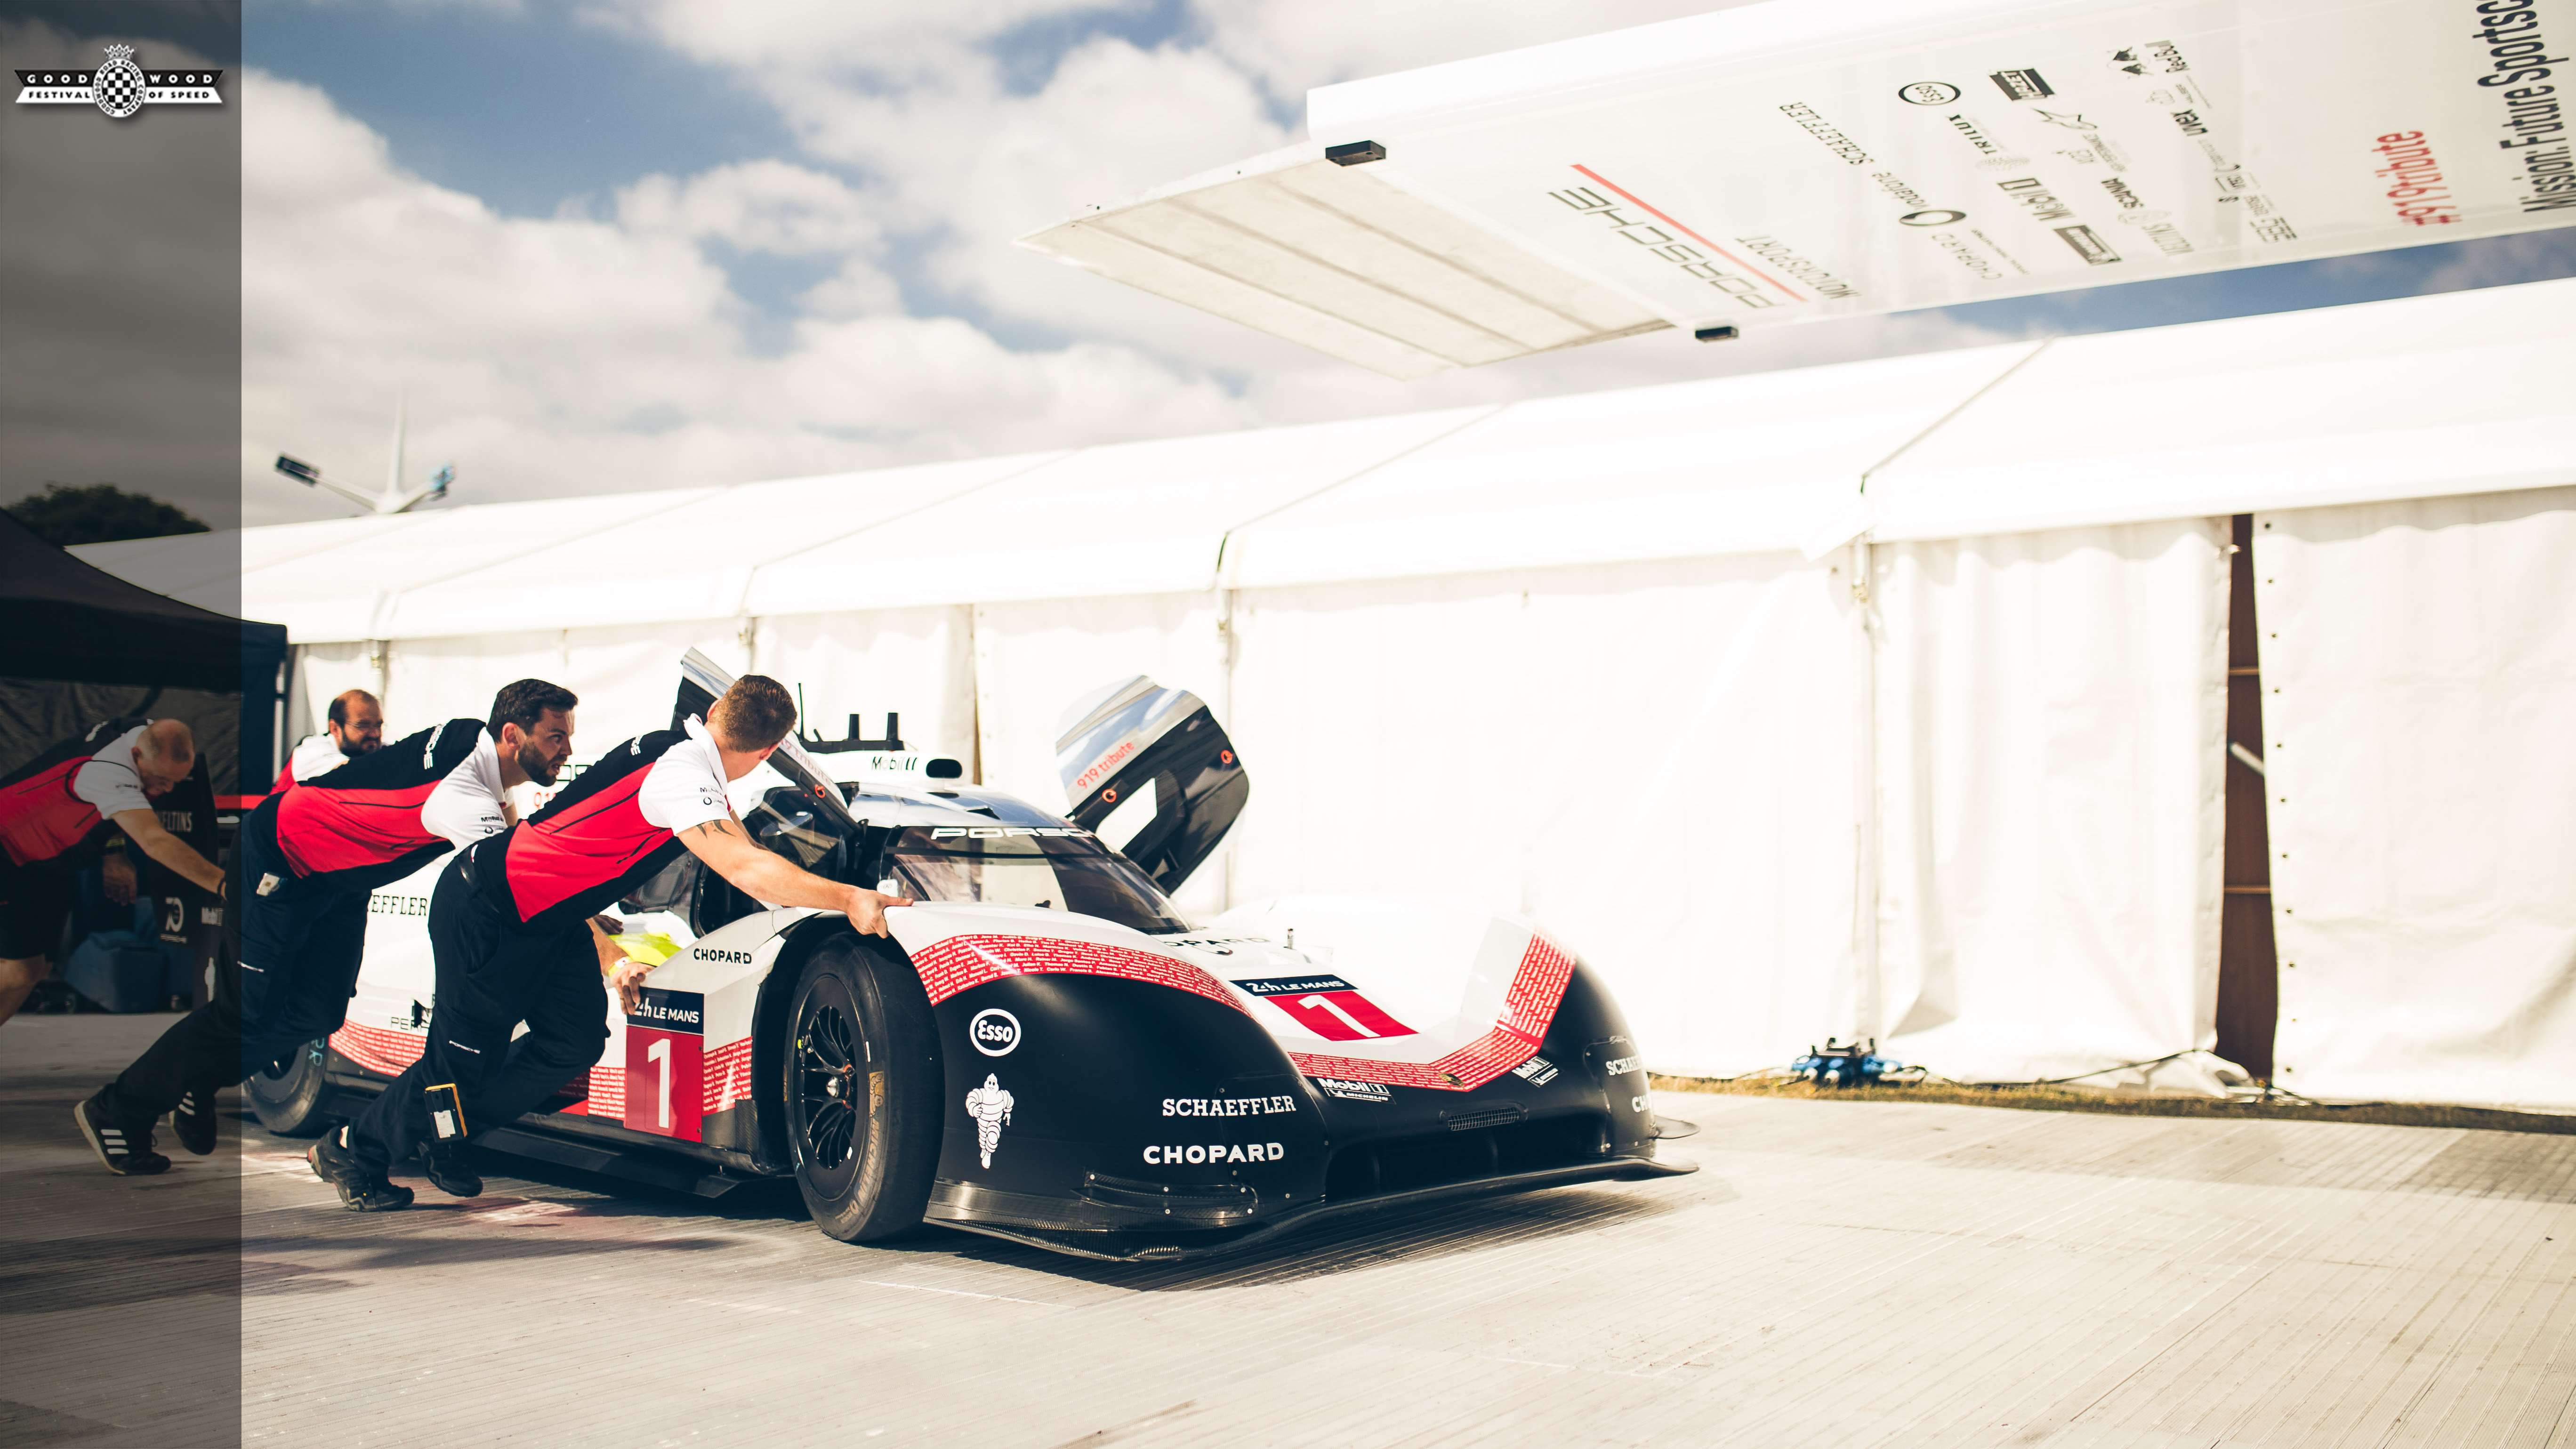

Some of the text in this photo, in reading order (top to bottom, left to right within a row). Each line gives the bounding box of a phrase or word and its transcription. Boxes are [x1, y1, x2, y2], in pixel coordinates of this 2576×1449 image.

[2145, 40, 2191, 72] Red Bull
[2472, 0, 2569, 87] Sportsc
[1779, 102, 1875, 165] SCHAEFFLER
[2170, 109, 2209, 137] uvex
[2499, 86, 2567, 149] Future
[1946, 114, 1997, 154] TRILUX
[1871, 171, 1931, 210] vodafone
[2101, 177, 2144, 209] SCANIA
[2371, 130, 2463, 226] #919tribute
[2009, 189, 2076, 221] Mobil
[1547, 187, 1786, 309] PORSCHE
[1931, 233, 2003, 281] CHOPARD
[1734, 235, 1861, 299] MOTORSPORT
[1077, 742, 1135, 789] 919 tribute
[931, 827, 1095, 840] PORSC
[371, 894, 427, 916] EFFLER
[693, 948, 752, 965] CHOPARD
[1303, 981, 1345, 990] MANS
[653, 1006, 667, 1019] LE
[668, 1008, 700, 1024] MANS
[977, 1020, 1014, 1042] Esso
[1297, 994, 1381, 1038] 1
[648, 1038, 671, 1129] 1
[1317, 1078, 1371, 1092] Mobil
[1346, 1092, 1389, 1101] MICHELIN
[1162, 1095, 1297, 1117] SCHAEFFLER
[858, 1119, 879, 1205] MICHELIN
[1143, 1143, 1284, 1164] CHOPARD
